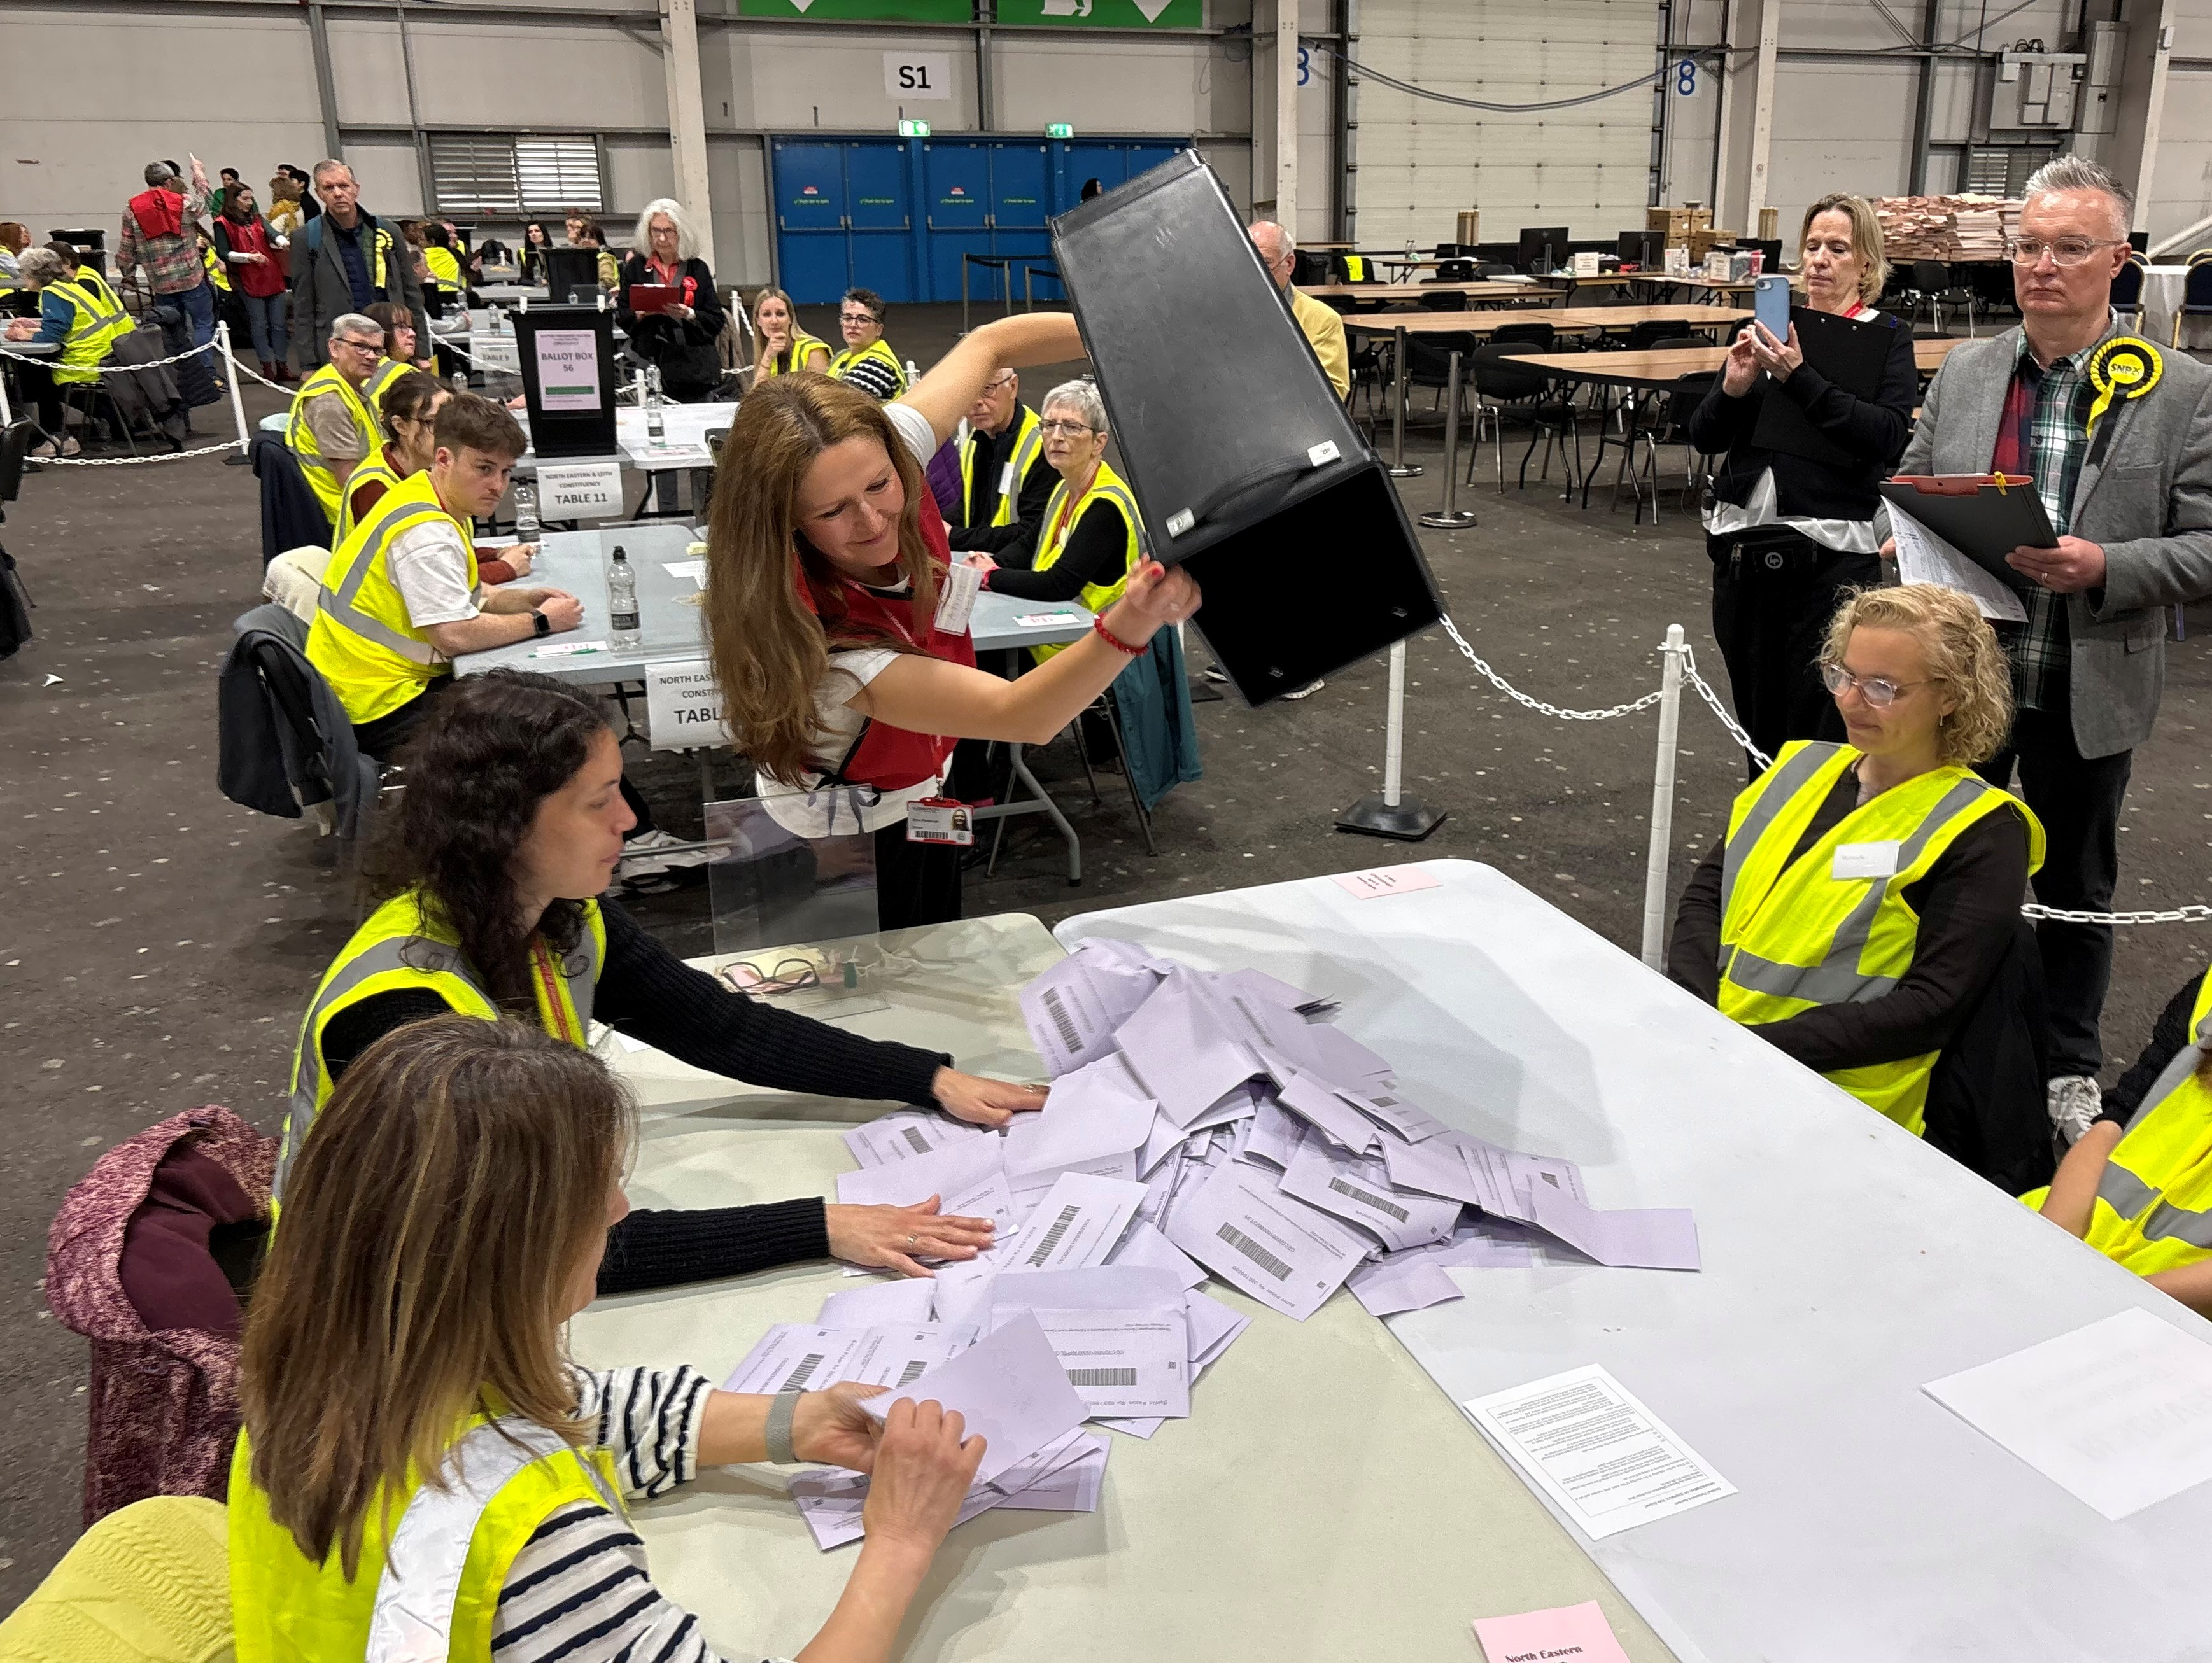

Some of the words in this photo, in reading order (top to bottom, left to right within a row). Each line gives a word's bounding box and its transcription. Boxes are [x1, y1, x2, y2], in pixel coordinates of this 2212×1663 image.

[899, 66, 931, 88] S1
[1678, 59, 1695, 95] 8
[541, 353, 572, 361] BALLOT
[2111, 363, 2132, 374] SNP
[555, 493, 591, 505] TABLE
[594, 493, 607, 502] 11
[660, 675, 692, 685] NORTH
[674, 707, 721, 724] TABL
[1505, 1653, 1537, 1663] North
[1539, 1646, 1584, 1659] Eastern
